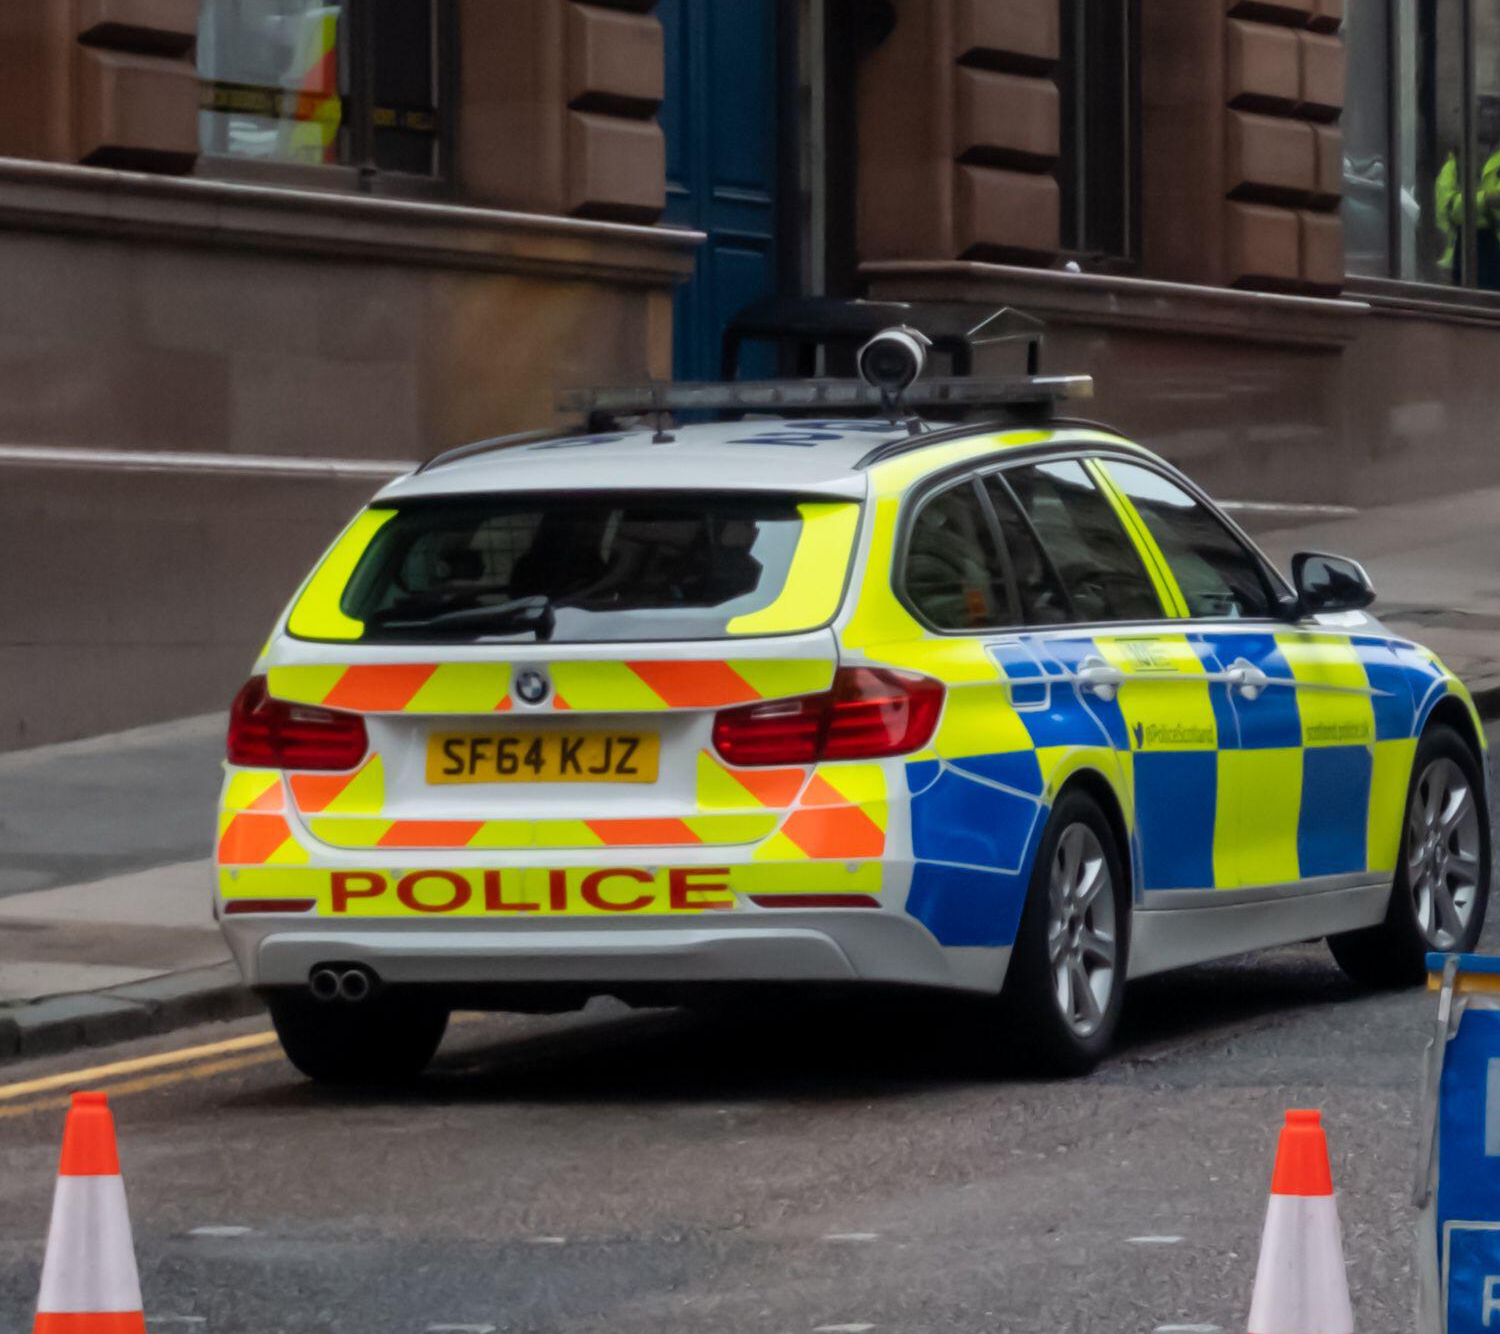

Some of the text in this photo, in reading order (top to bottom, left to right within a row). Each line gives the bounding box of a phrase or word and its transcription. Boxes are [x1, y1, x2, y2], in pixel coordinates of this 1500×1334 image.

[443, 737, 641, 775] SF64 KJZ
[330, 867, 735, 914] POLICE
